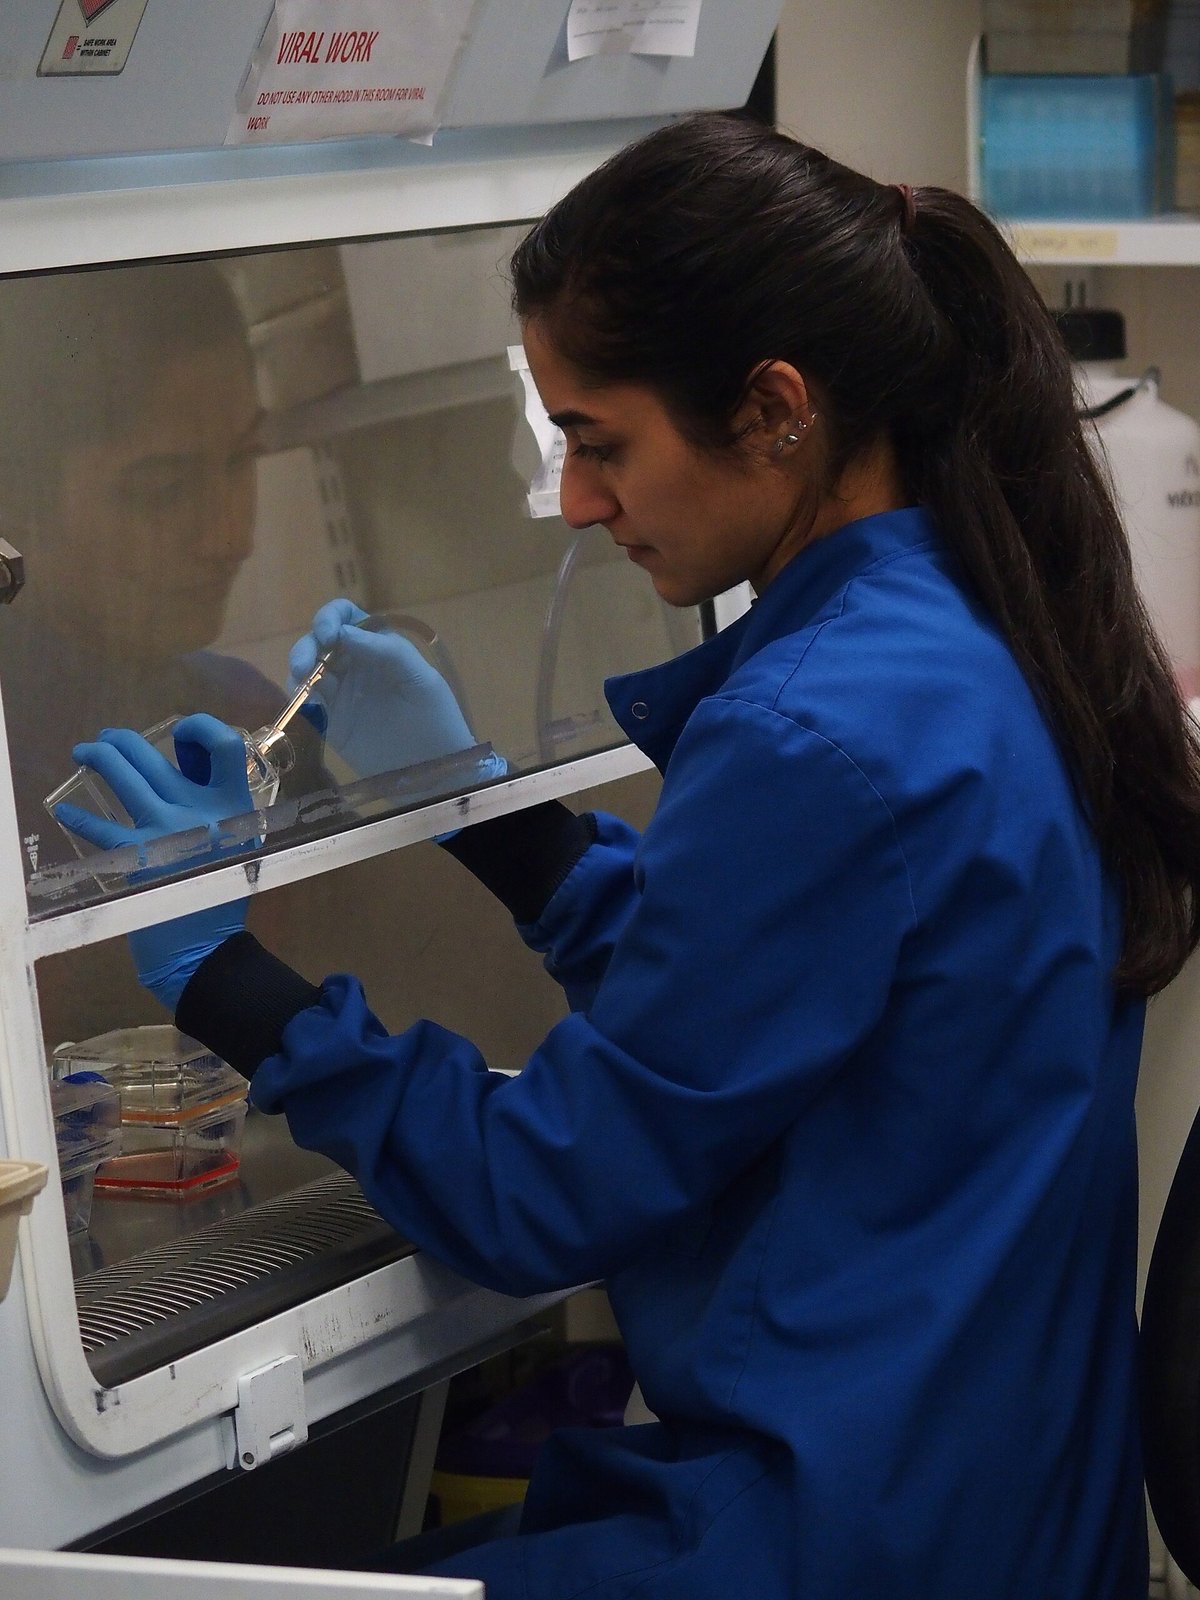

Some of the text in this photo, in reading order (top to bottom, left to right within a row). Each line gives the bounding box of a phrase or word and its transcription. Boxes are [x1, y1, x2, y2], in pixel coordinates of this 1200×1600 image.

[106, 38, 117, 46] AREA
[277, 31, 379, 64] VIRAL WORK
[257, 87, 426, 105] DO NOT USE ANY OTHER HOOD IN THIS ROOM FOR VIRAL
[247, 116, 270, 130] WORK
